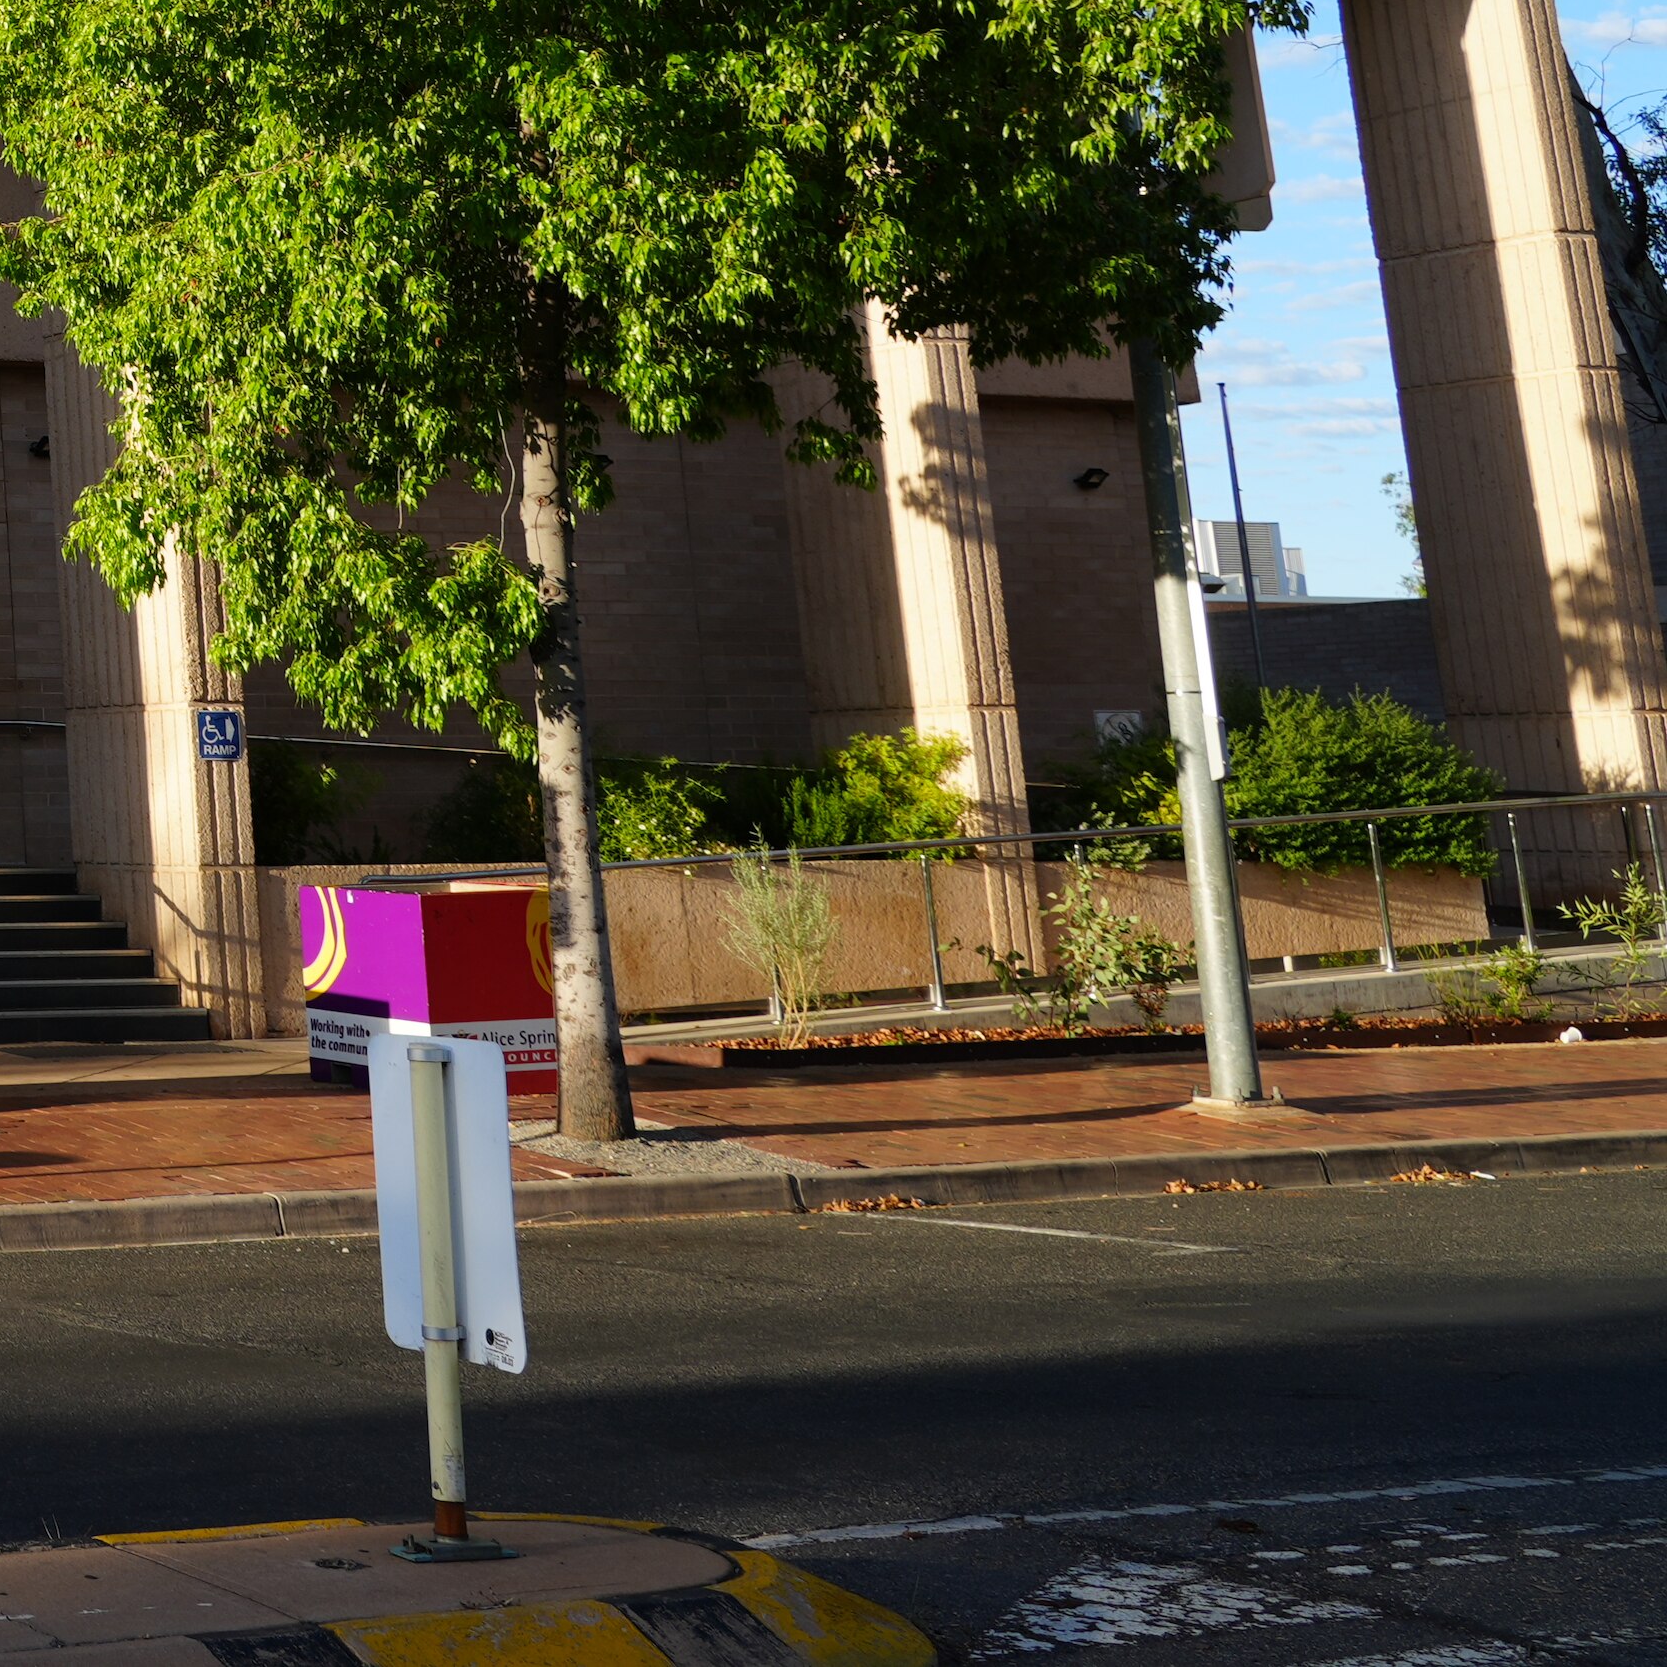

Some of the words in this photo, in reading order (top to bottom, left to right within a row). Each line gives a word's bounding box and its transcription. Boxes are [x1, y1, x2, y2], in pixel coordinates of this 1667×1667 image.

[203, 744, 237, 755] RAMP
[310, 1018, 344, 1039] Working
[346, 1023, 365, 1038] with
[311, 1035, 327, 1049] the
[328, 1040, 368, 1056] commun
[481, 1031, 515, 1046] Alice
[519, 1030, 556, 1048] Sprin
[507, 1051, 552, 1062] OUNC
